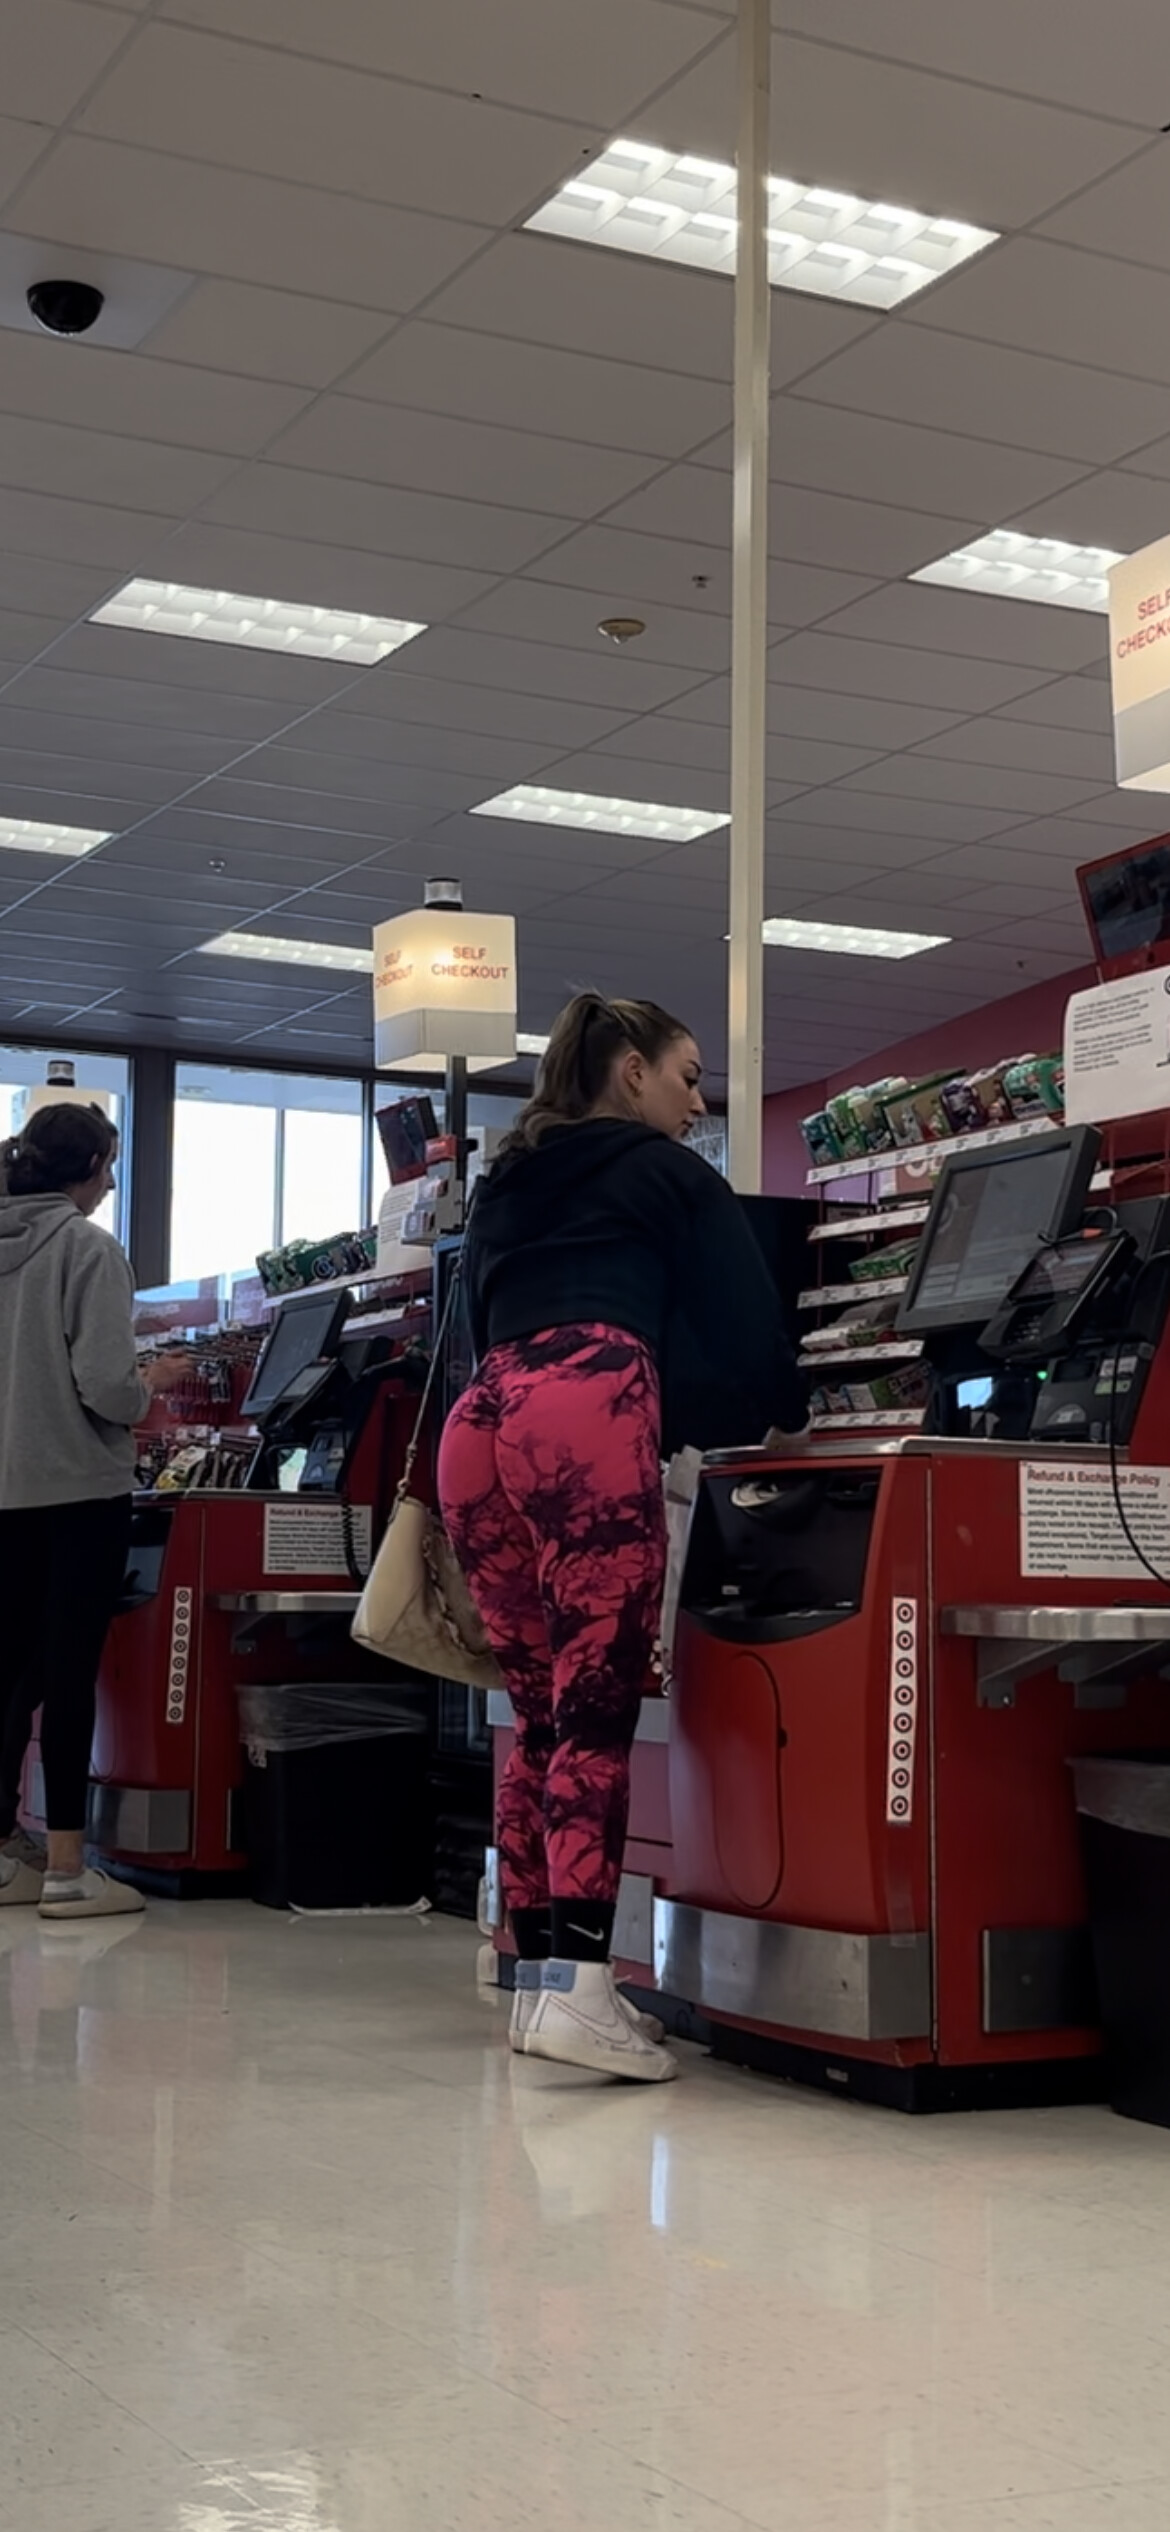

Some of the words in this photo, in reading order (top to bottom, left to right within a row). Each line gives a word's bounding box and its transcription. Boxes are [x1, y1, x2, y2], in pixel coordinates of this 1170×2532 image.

[1138, 588, 1170, 620] SELF
[1117, 616, 1170, 659] CHECK
[452, 946, 487, 960] SELF
[431, 963, 509, 979] CHECKOUT
[1027, 1469, 1065, 1482] Refund
[1067, 1470, 1075, 1482] &
[1129, 1473, 1160, 1488] Policy
